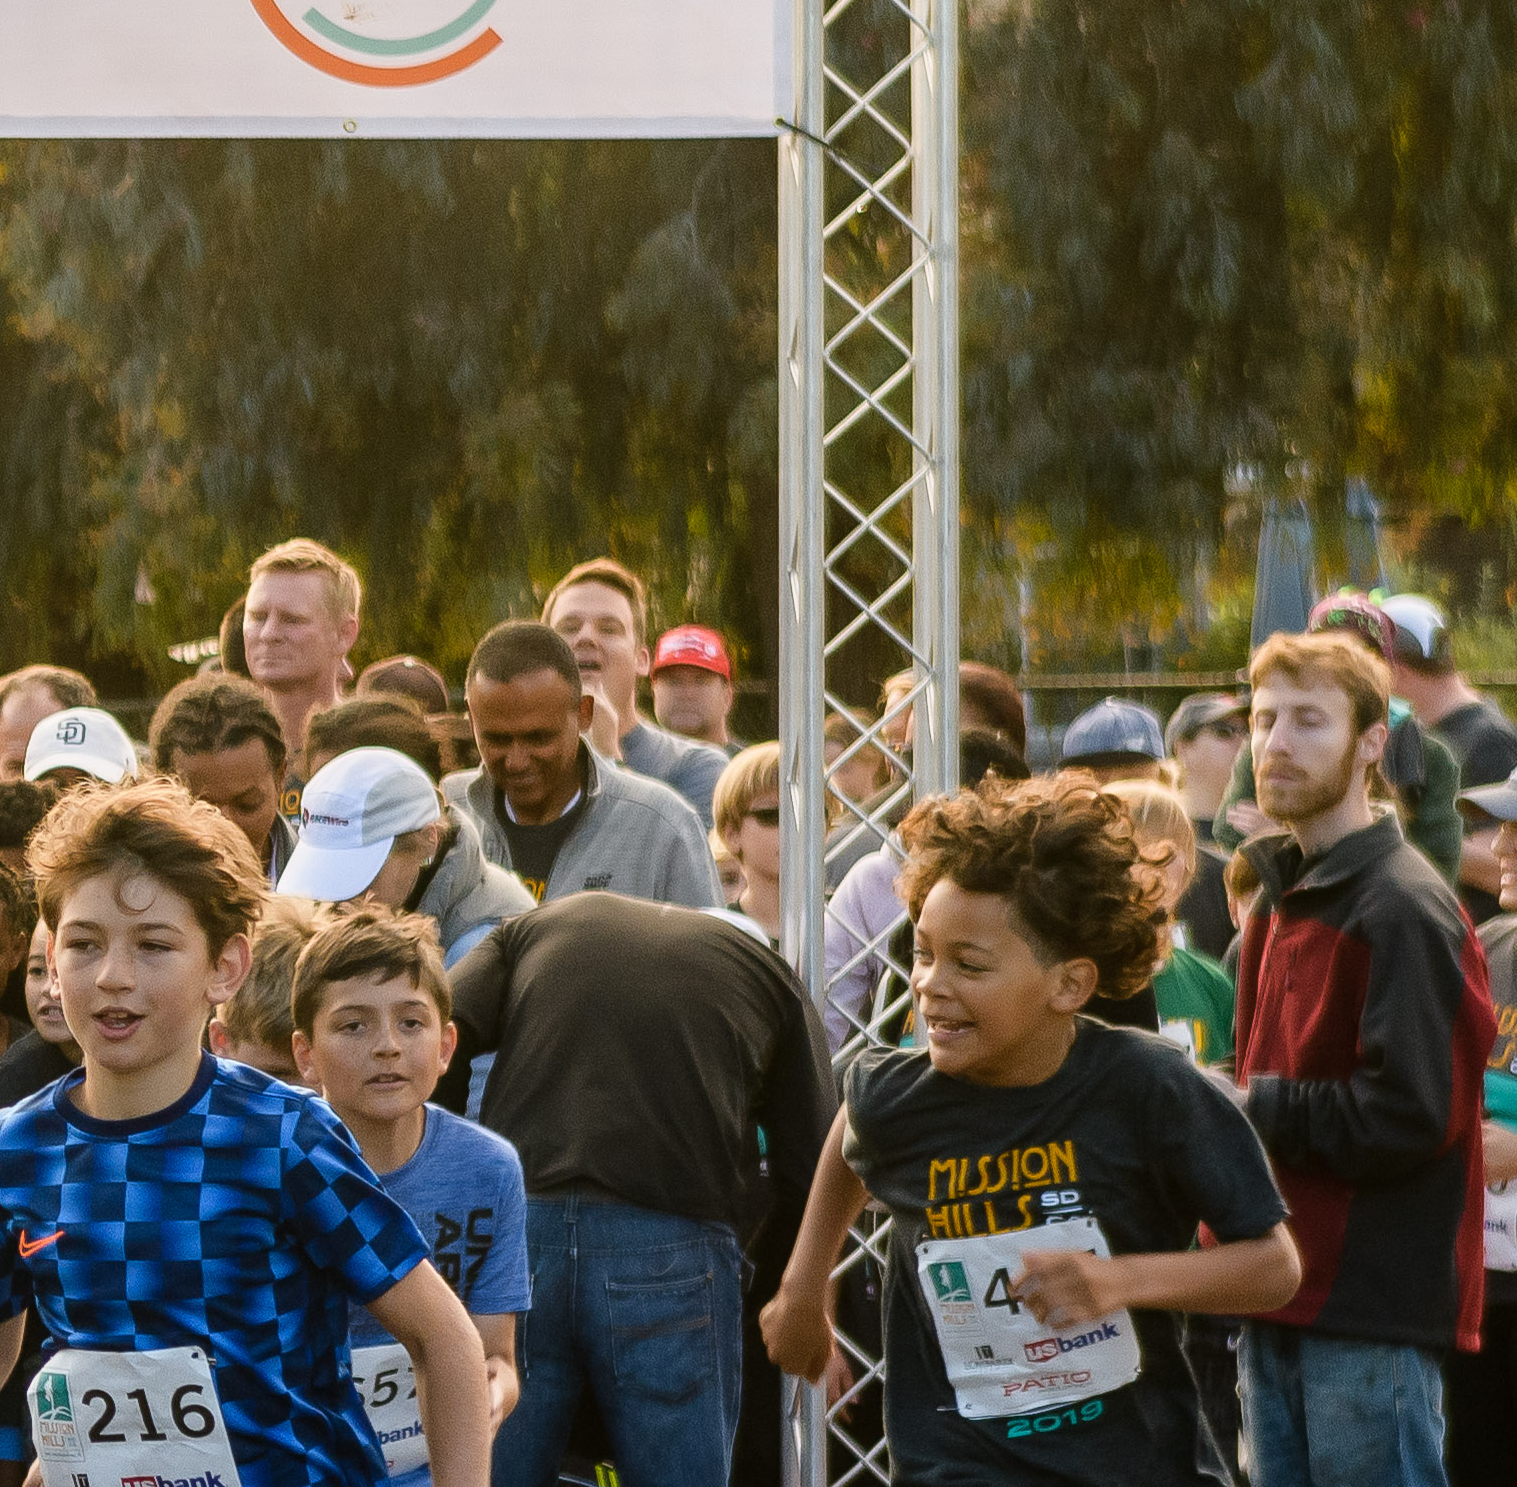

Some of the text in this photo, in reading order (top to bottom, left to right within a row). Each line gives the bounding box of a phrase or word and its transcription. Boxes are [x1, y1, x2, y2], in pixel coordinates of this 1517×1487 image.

[928, 1140, 1077, 1200] MISSION
[926, 1194, 1032, 1238] HILLS
[1040, 1189, 1080, 1207] SD
[82, 1384, 215, 1443] 216
[1007, 1399, 1104, 1438] 2019
